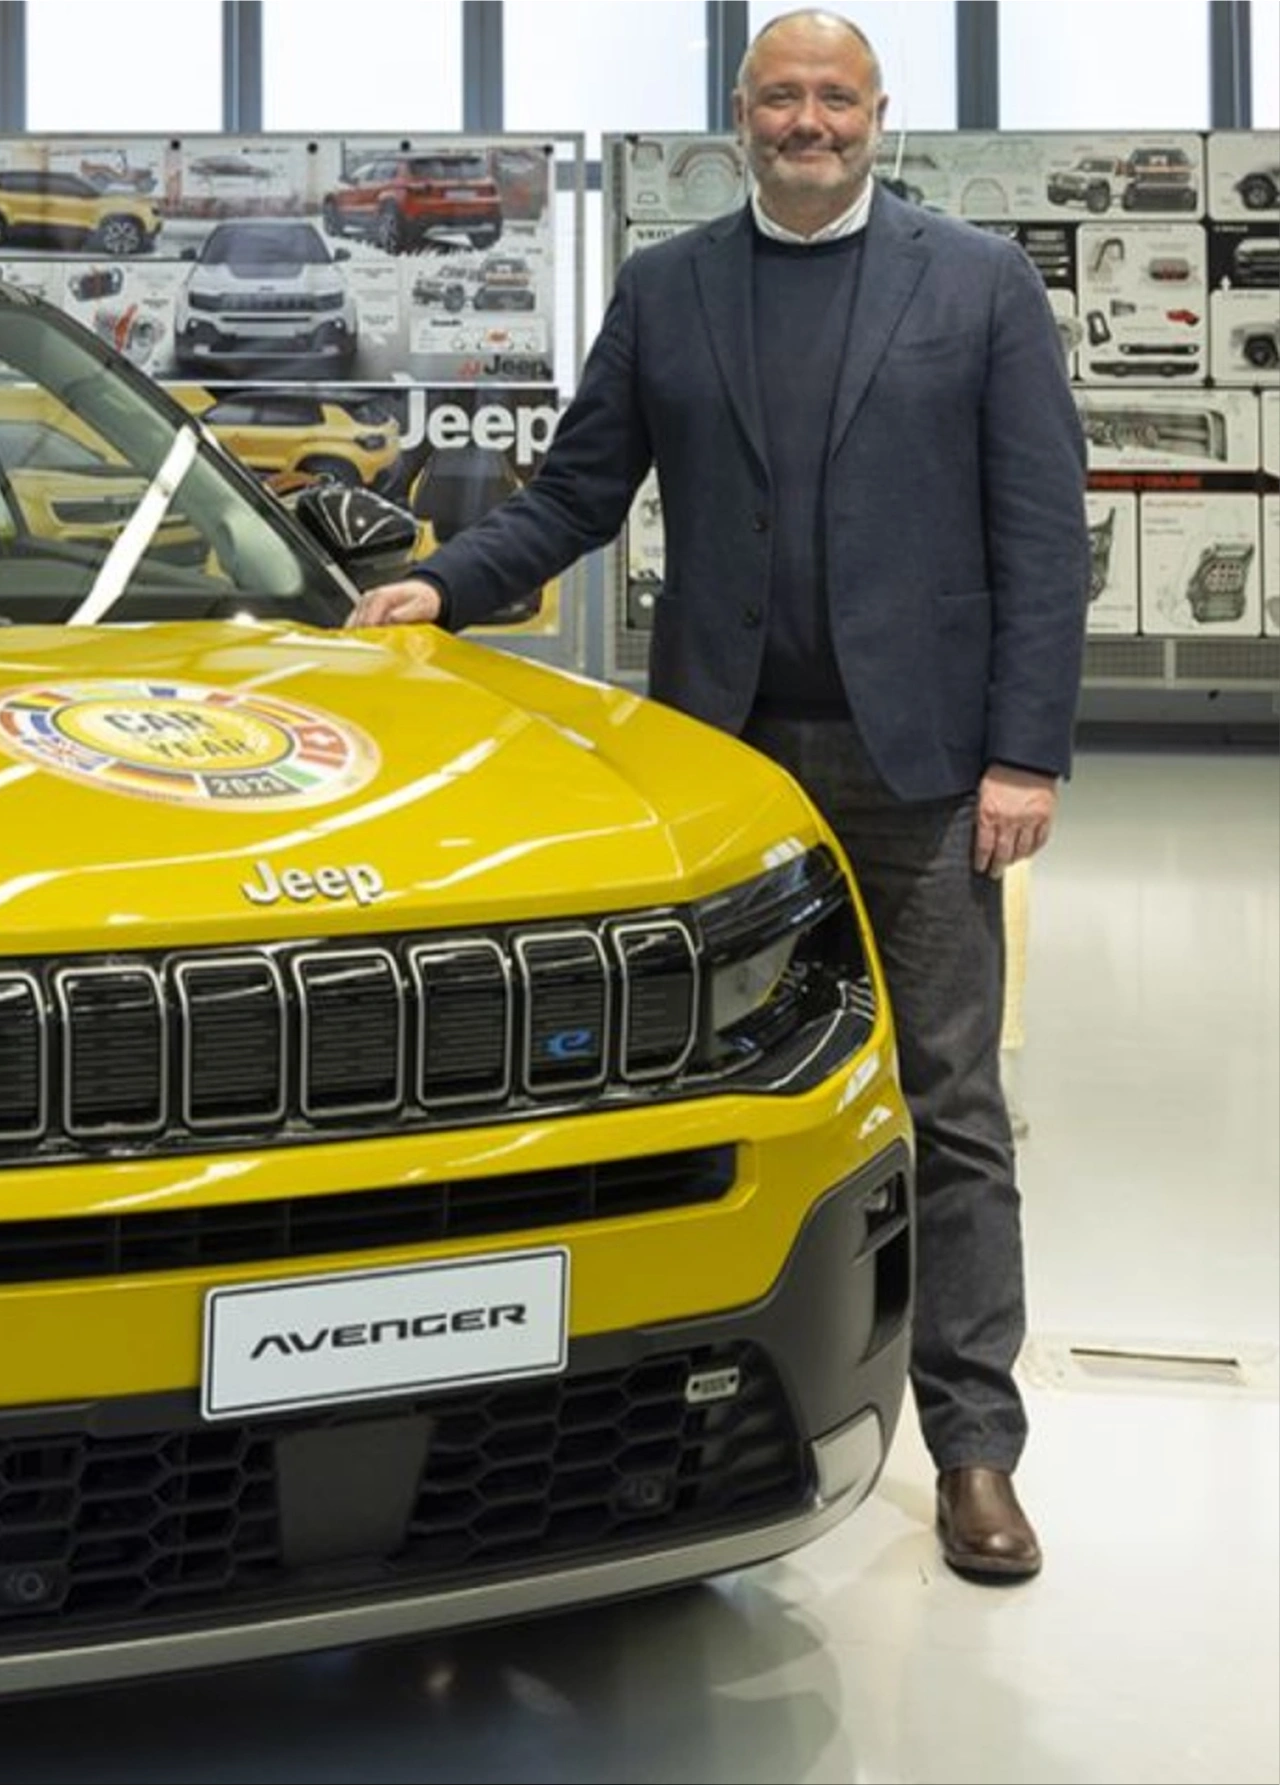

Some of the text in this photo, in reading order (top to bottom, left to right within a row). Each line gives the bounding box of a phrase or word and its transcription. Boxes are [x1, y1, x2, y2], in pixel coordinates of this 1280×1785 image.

[484, 354, 546, 380] Jeep
[394, 388, 562, 465] Jeep
[104, 711, 214, 735] CAR
[144, 739, 256, 758] YEAR
[241, 860, 384, 907] Jeep
[249, 1303, 527, 1360] AVENGER
